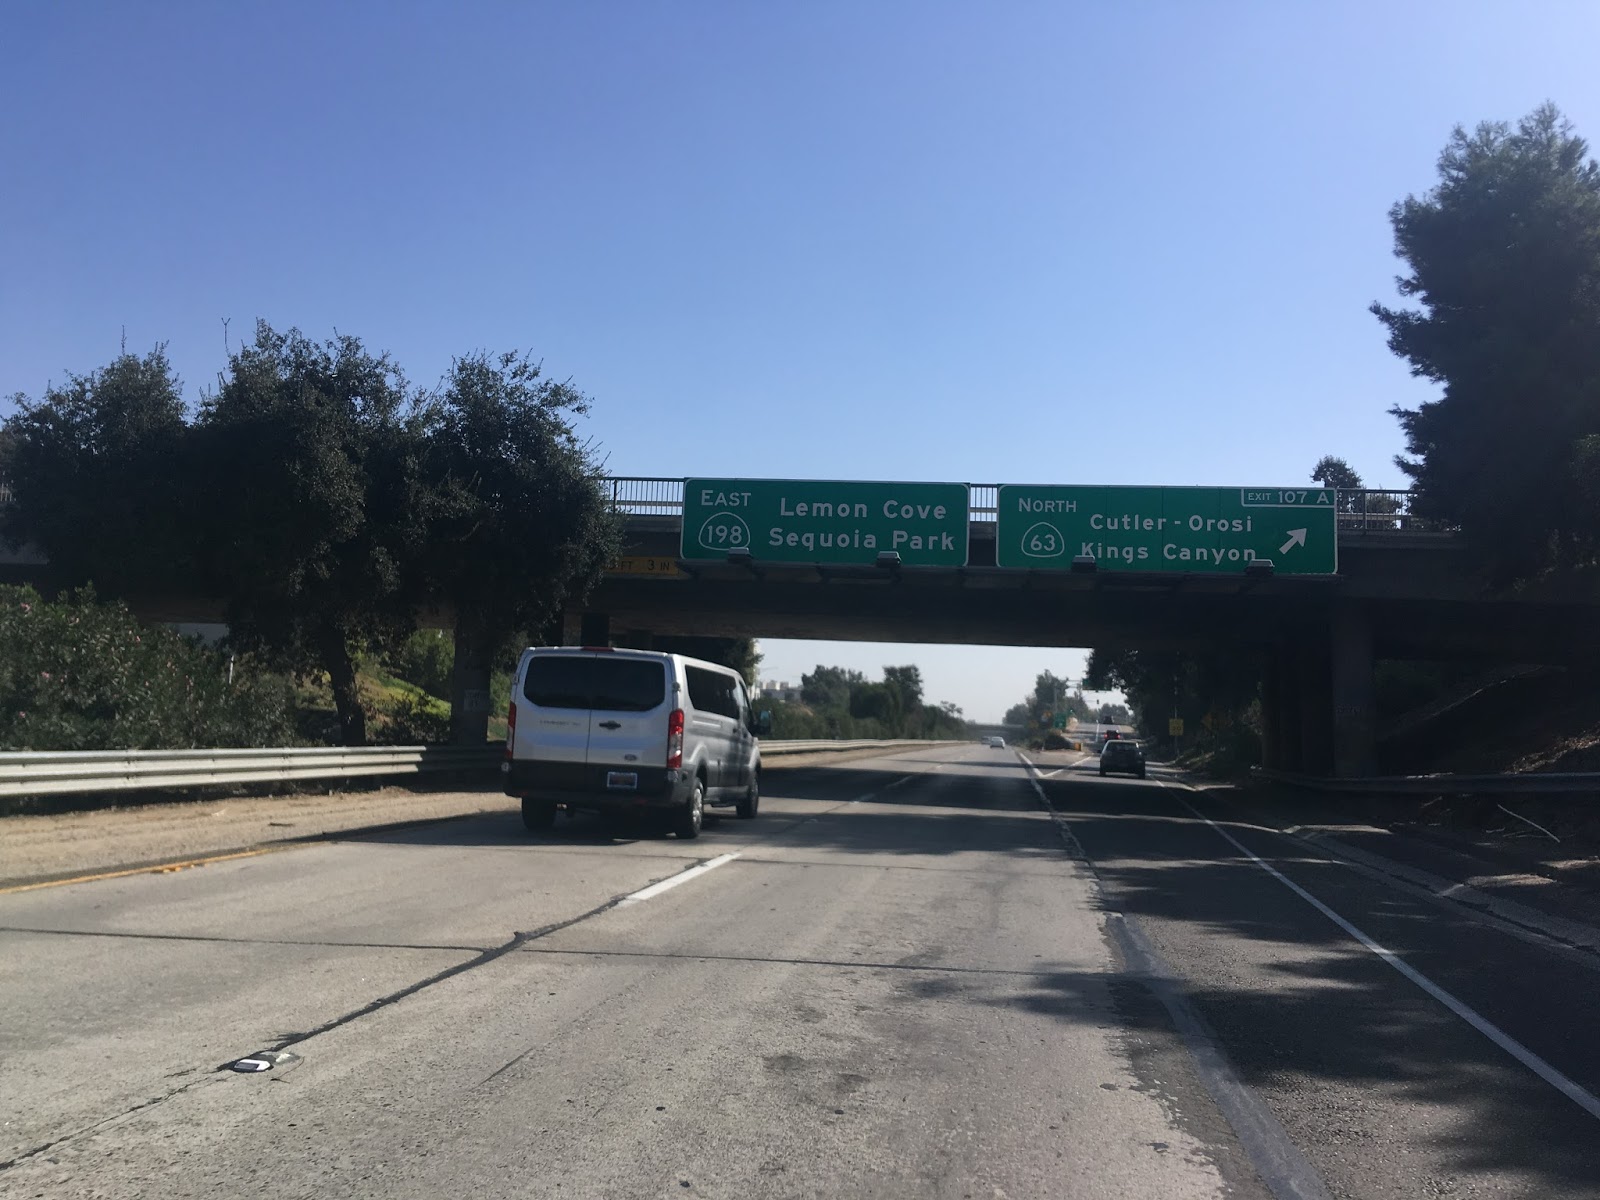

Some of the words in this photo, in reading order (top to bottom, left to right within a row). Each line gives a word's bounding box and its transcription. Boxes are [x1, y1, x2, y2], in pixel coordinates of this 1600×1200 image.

[701, 489, 751, 506] EAST
[1018, 498, 1077, 513] NORTH
[1247, 492, 1271, 501] EXIT
[1278, 491, 1307, 503] 107
[1316, 491, 1330, 504] A
[780, 497, 868, 517] Lemon
[883, 500, 947, 519] Cove
[1090, 513, 1167, 531] Cutler
[1188, 514, 1252, 532] Orosi
[707, 525, 742, 544] 198
[768, 527, 877, 551] Sequoia
[892, 530, 954, 550] Park
[1030, 534, 1056, 551] 63
[1081, 542, 1149, 564] Kings
[1163, 543, 1256, 565] Canyon
[621, 560, 632, 570] FT
[647, 560, 655, 571] 3
[660, 562, 670, 571] IN
